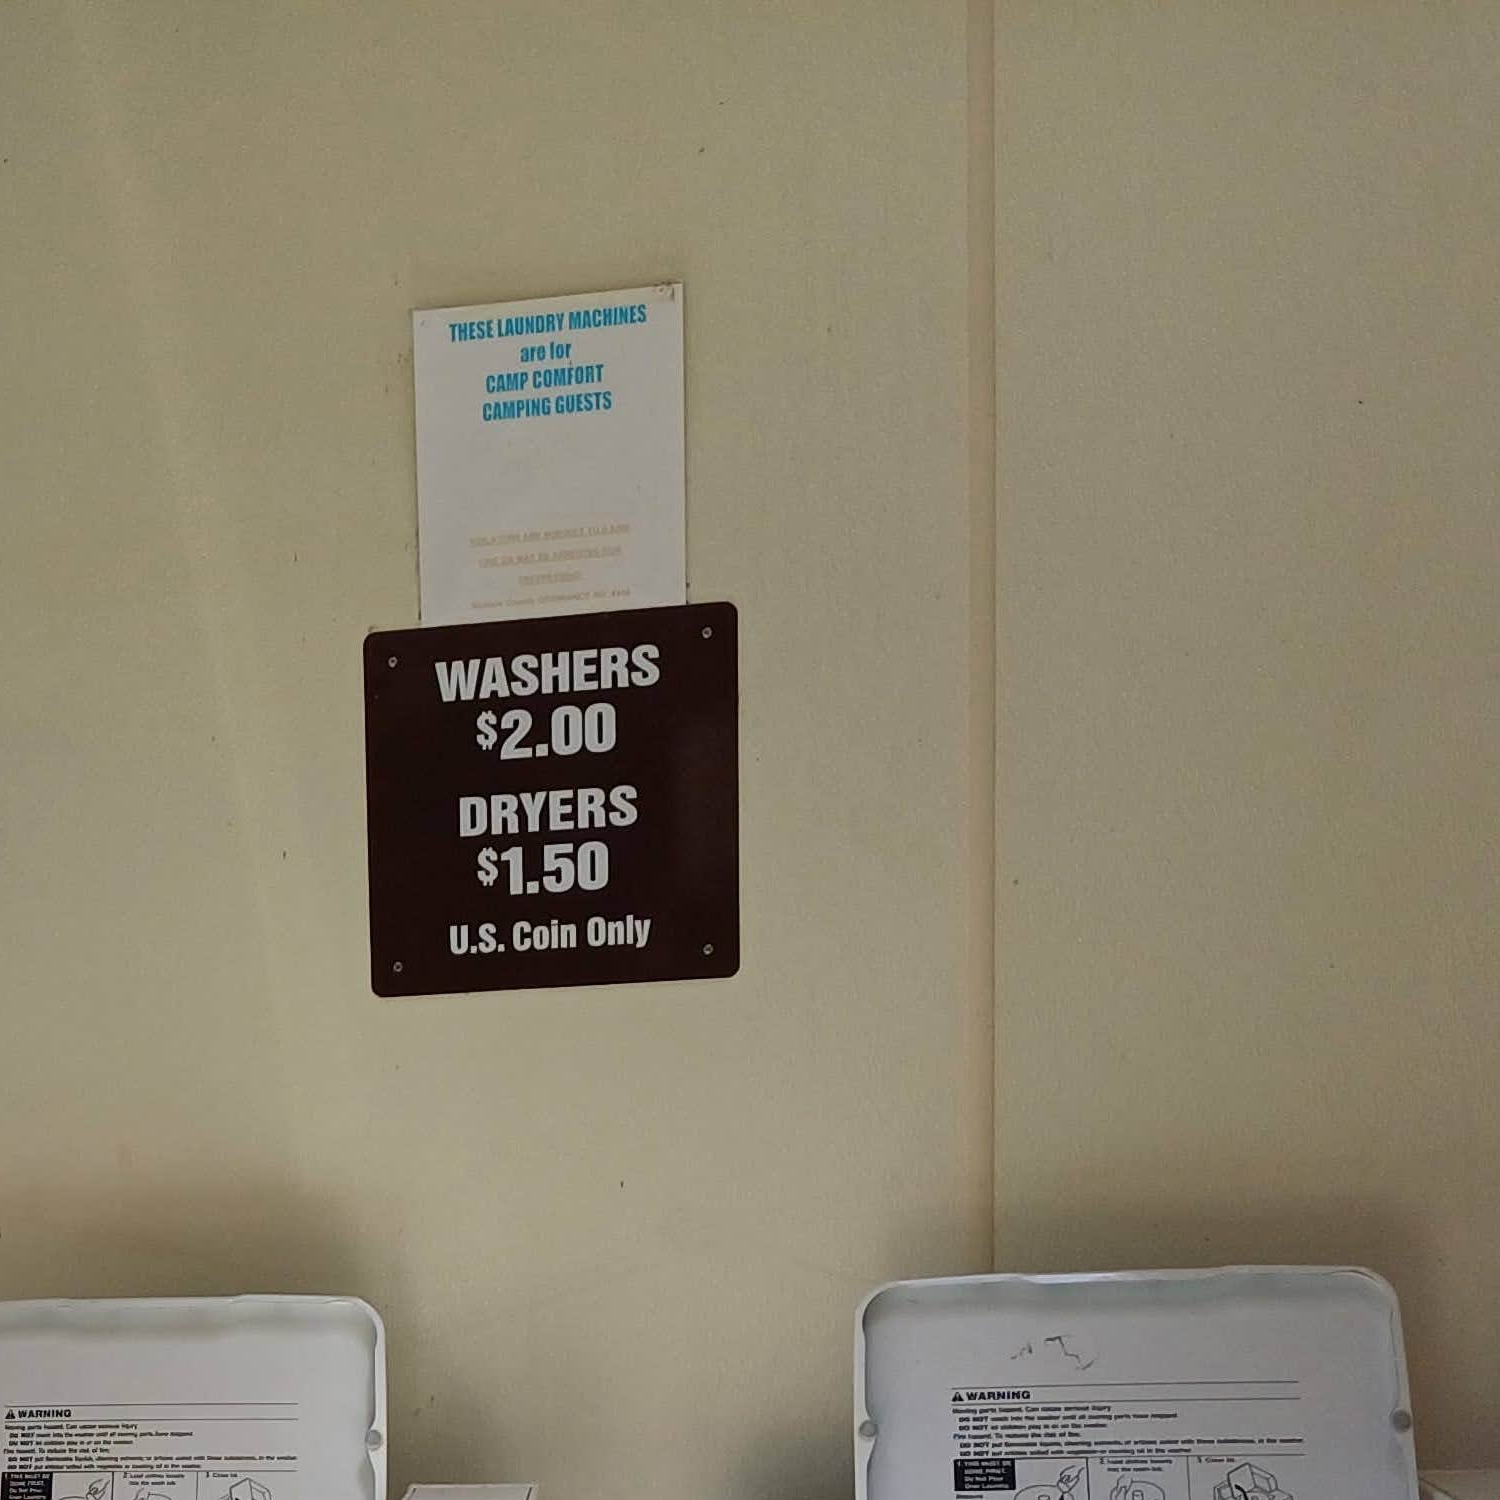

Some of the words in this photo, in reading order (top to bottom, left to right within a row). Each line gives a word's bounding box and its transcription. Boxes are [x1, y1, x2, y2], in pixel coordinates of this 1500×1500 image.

[449, 322, 494, 342] THESE
[497, 312, 565, 337] LAUNDRY
[569, 304, 647, 330] MACHINES
[520, 344, 546, 362] are
[549, 340, 572, 359] for
[486, 372, 529, 393] CAMP
[532, 364, 605, 389] COMFORT
[483, 397, 552, 421] CAMPING
[555, 390, 613, 415] GUESTS
[434, 643, 661, 703] WASHERS
[476, 702, 617, 760] $2.00
[459, 785, 638, 838] DRYERS
[476, 841, 610, 896] $1.50
[449, 924, 506, 955] U.S.
[512, 919, 578, 952] Coin
[586, 914, 652, 949] Only
[17, 1409, 72, 1418] WARNING
[966, 1390, 1031, 1401] WARNING
